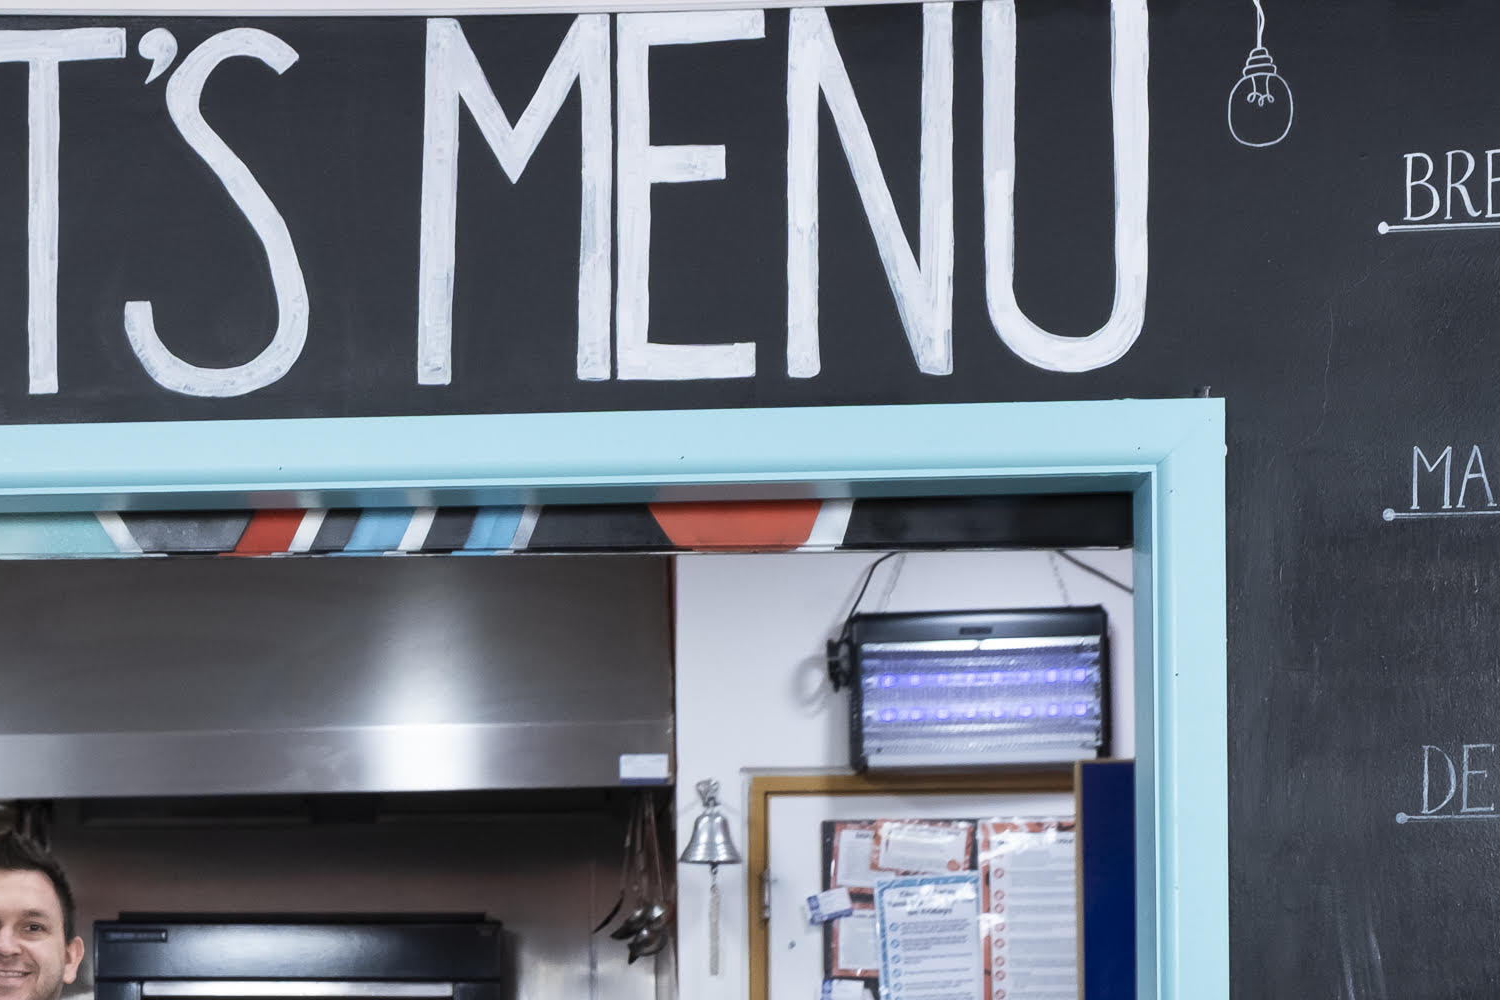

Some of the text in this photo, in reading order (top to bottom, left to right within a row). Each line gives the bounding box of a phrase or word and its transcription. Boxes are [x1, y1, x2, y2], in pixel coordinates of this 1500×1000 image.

[418, 0, 1149, 386] MENU
[1410, 444, 1497, 509] MA
[1421, 743, 1496, 814] DE
